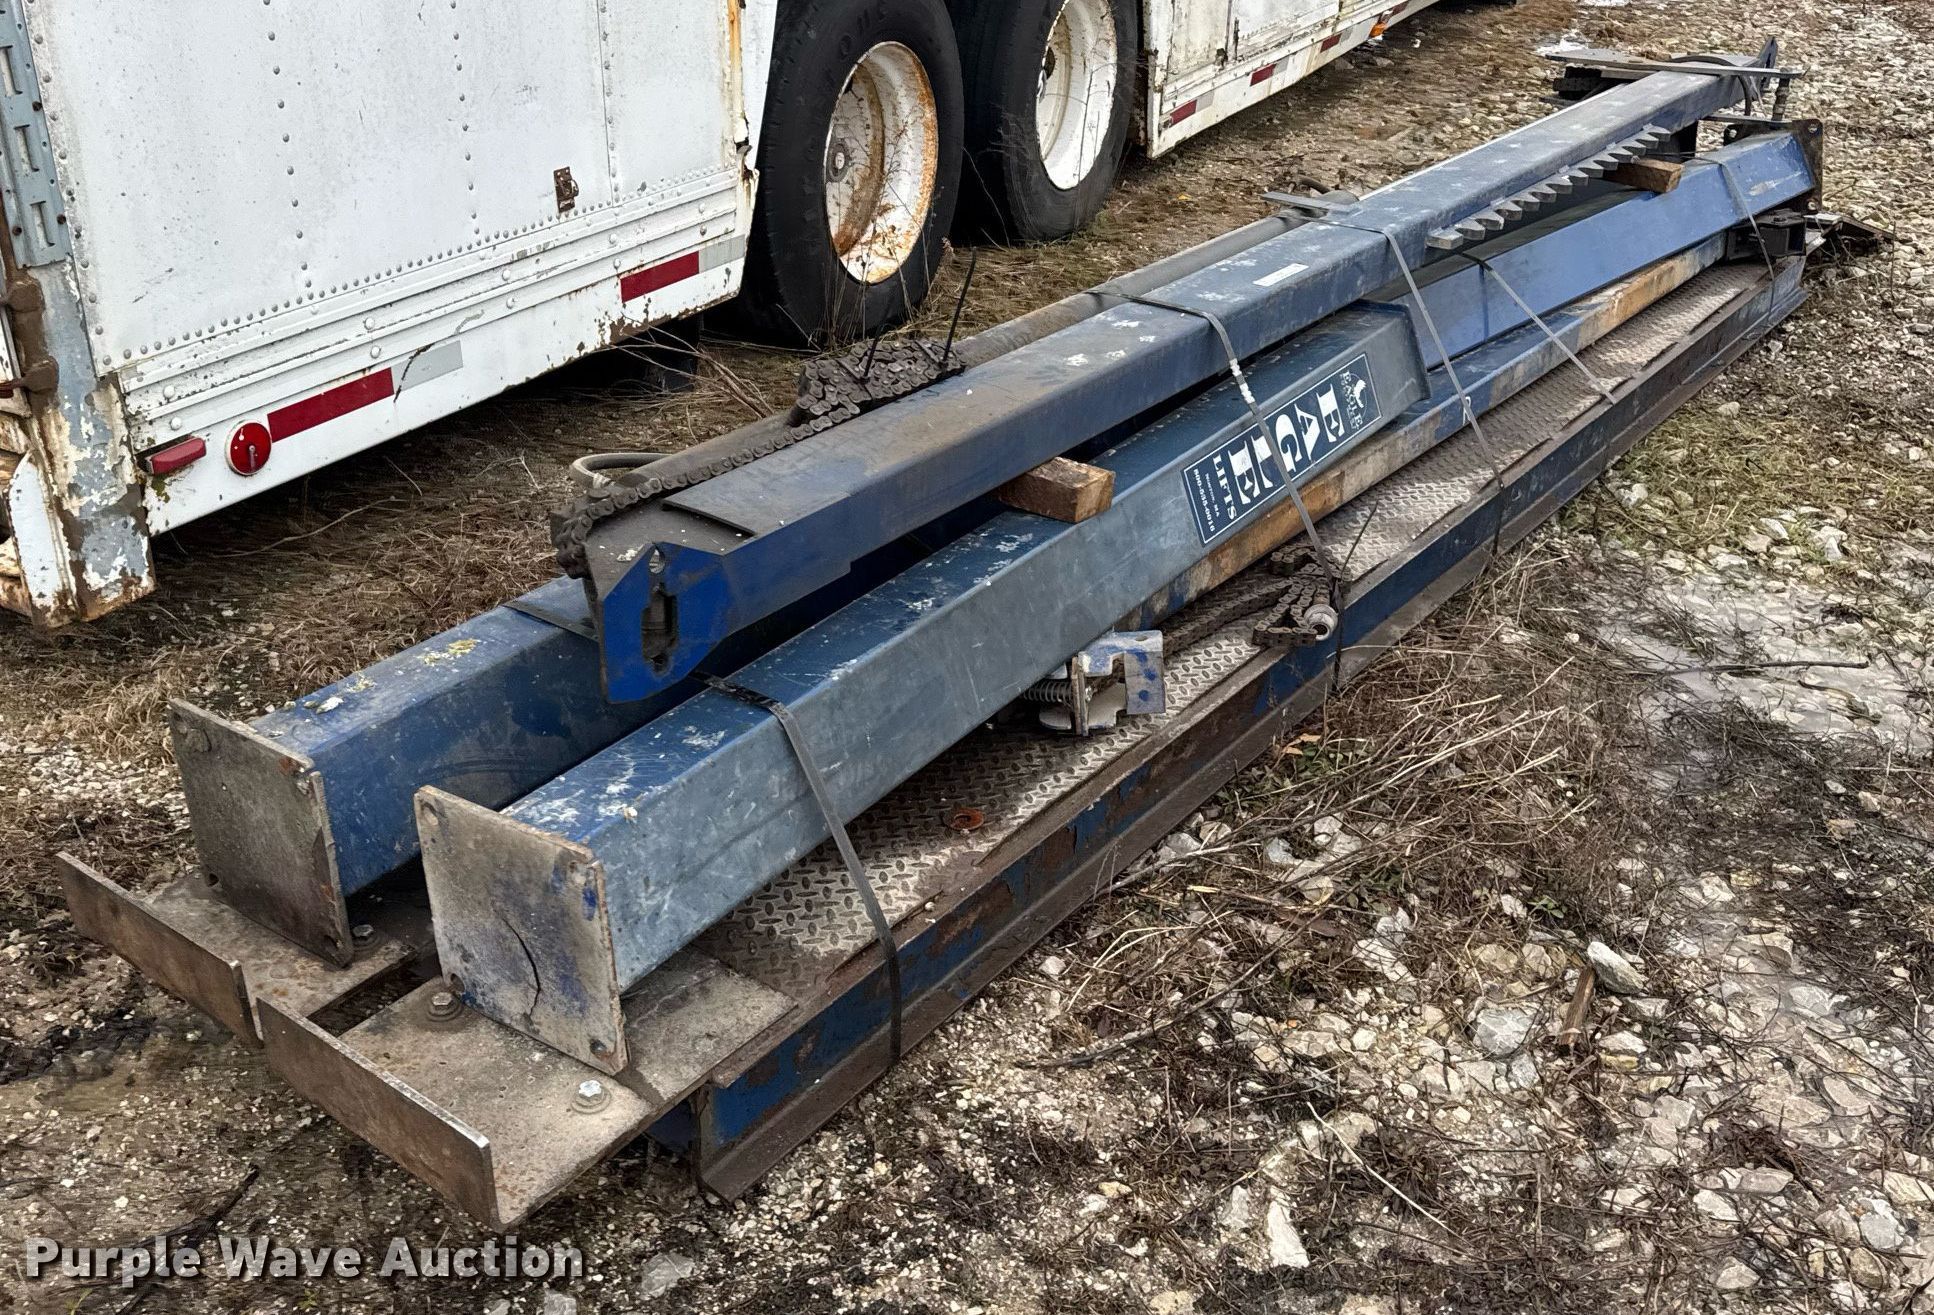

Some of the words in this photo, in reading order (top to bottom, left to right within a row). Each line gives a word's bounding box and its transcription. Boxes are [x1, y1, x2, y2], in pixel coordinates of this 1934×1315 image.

[1342, 371, 1363, 428] EAGLE
[1228, 383, 1345, 505] EAGLE
[1213, 453, 1237, 520] LIFTS
